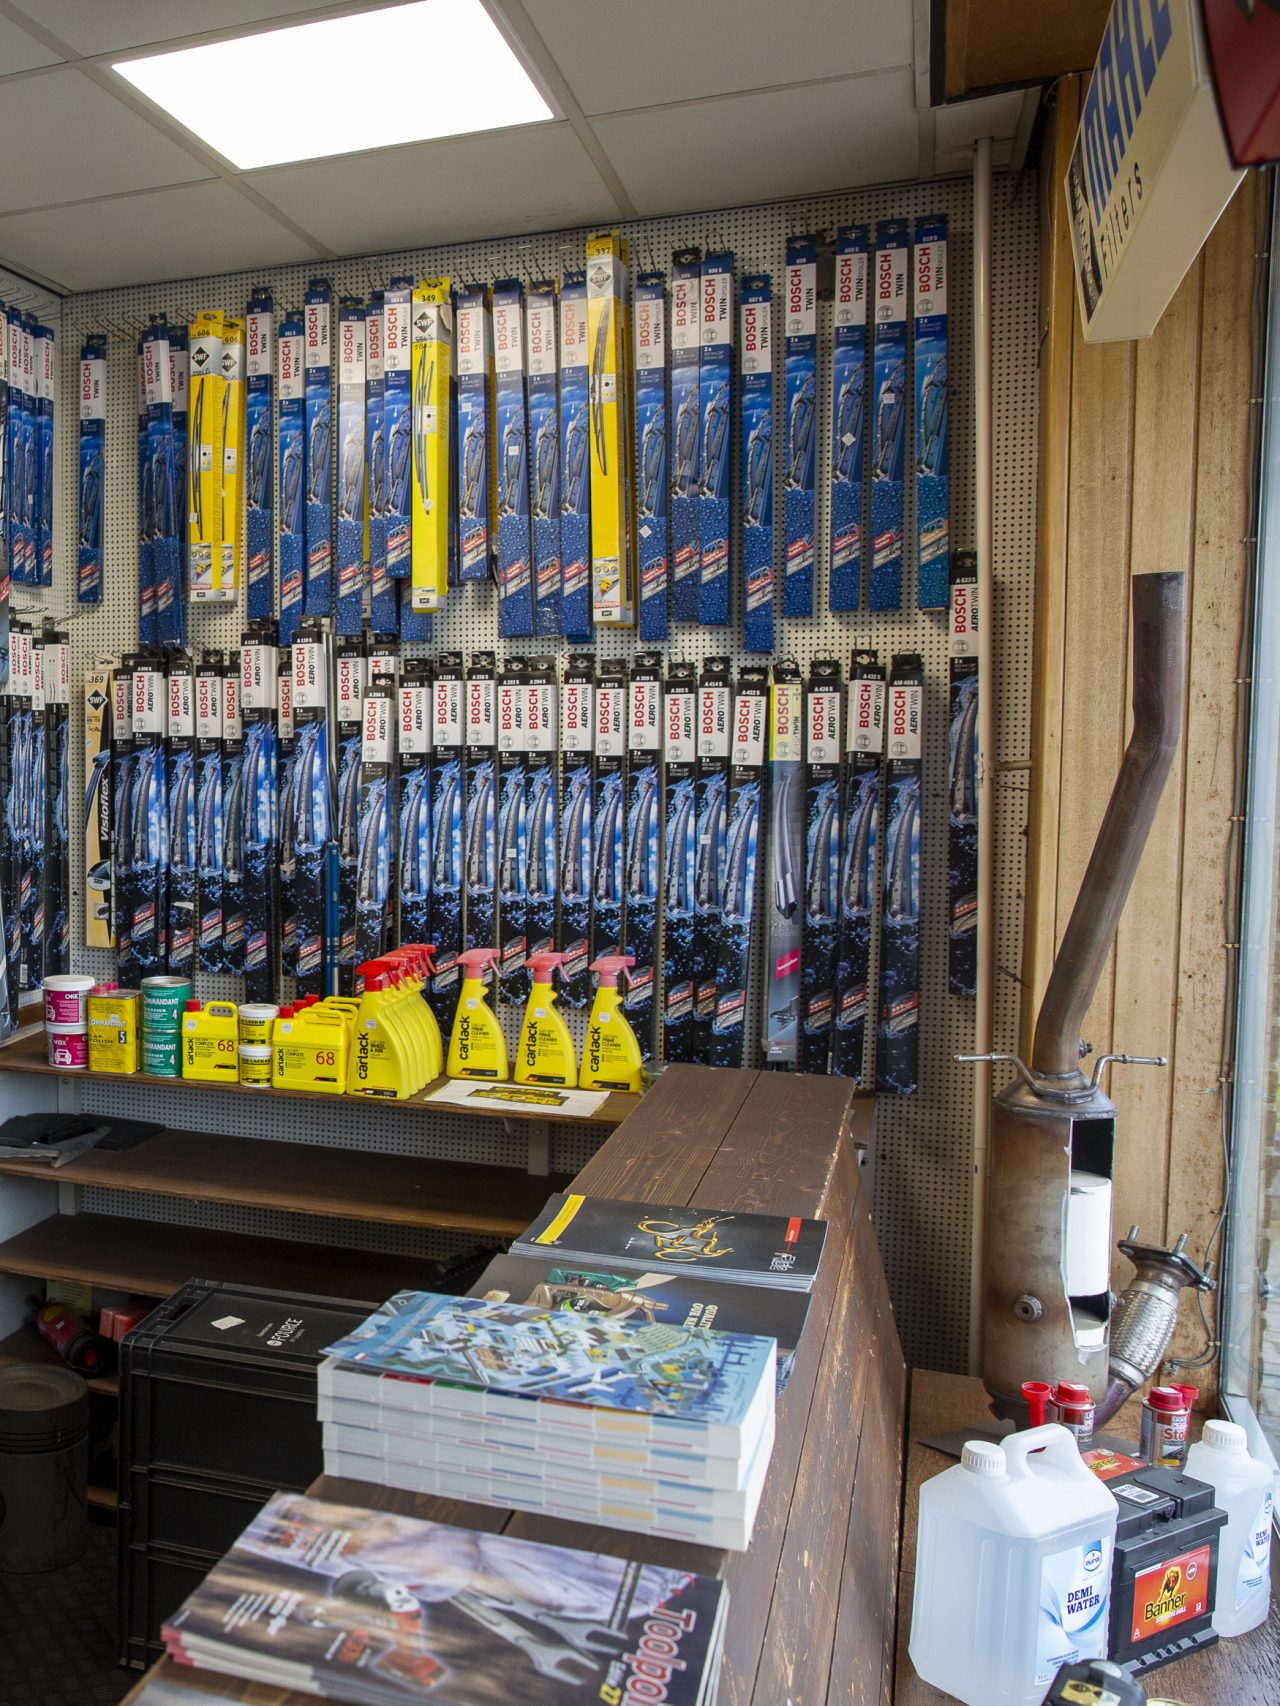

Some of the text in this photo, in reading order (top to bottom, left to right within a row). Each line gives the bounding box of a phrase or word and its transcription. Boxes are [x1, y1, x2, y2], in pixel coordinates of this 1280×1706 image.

[1099, 161, 1143, 280] Filters
[595, 246, 611, 256] 337
[590, 273, 610, 283] SWF
[790, 267, 802, 314] BOSCH
[879, 253, 891, 300] BOSCH
[895, 273, 904, 298] TWIN
[421, 293, 436, 303] 349
[197, 327, 211, 338] 606
[249, 316, 258, 356] BOSCH
[388, 307, 398, 350] BOSCH
[415, 318, 433, 328] SWF
[745, 307, 756, 352] BOSCH
[193, 352, 209, 362] SWF
[970, 587, 979, 633] AEROTWIN
[89, 675, 104, 683] 369
[296, 647, 305, 687] BOSCH
[89, 696, 104, 704] SWF
[136, 674, 144, 713] BOSCH
[437, 684, 447, 725] BOSCH
[567, 688, 578, 730] BOSCH
[648, 684, 656, 727] AEROTWIN
[702, 690, 714, 734] BOSCH
[777, 687, 789, 736] BOSCH
[859, 684, 871, 729] BOSCH
[873, 683, 882, 729] AEROTWIN
[910, 690, 918, 735] AEROTWIN
[752, 699, 762, 743] AEROTWIN
[100, 775, 110, 842] Visioflex
[172, 1009, 179, 1020] 4
[120, 1031, 126, 1043] 5
[217, 1039, 235, 1053] 68
[357, 1032, 369, 1080] carlack
[459, 1014, 470, 1061] carlack
[527, 1020, 538, 1067] carlack
[590, 1025, 602, 1073] carlack
[315, 1051, 336, 1066] 68
[1067, 1585, 1093, 1604] DEMI
[1067, 1594, 1100, 1616] WATER
[1145, 1592, 1187, 1621] Banner
